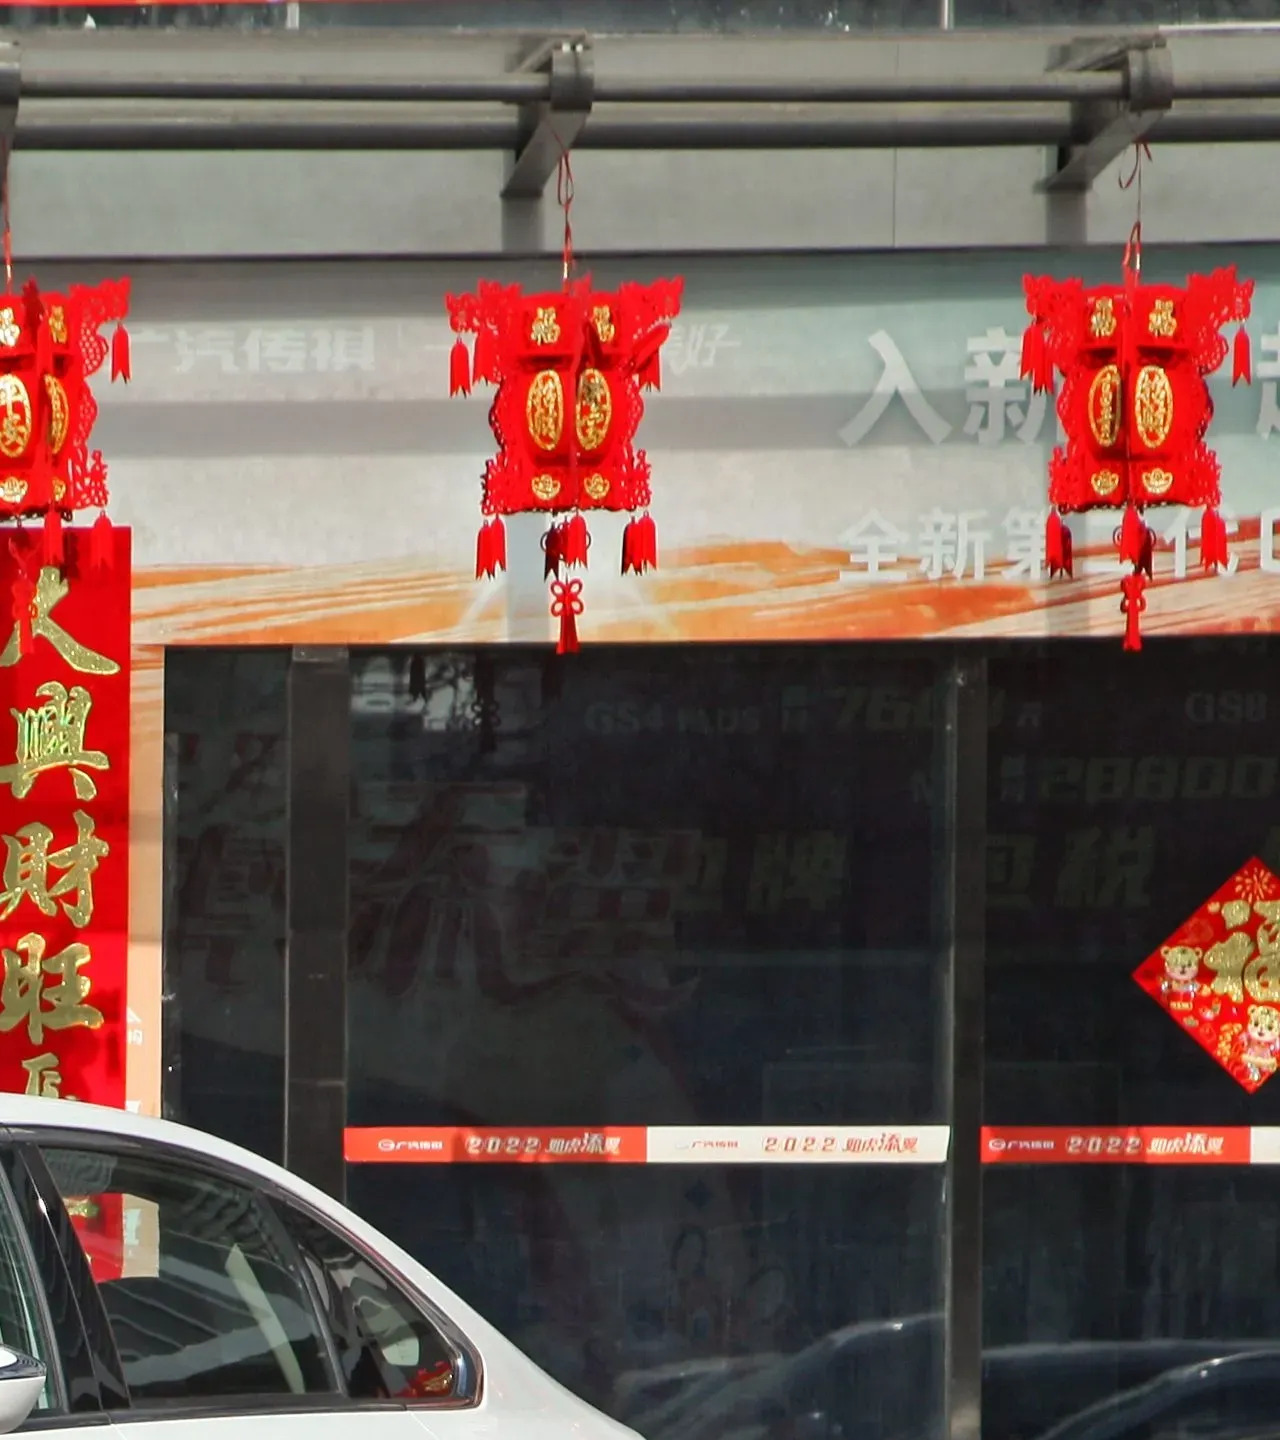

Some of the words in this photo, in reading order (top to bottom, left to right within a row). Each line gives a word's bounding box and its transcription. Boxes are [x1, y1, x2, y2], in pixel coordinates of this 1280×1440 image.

[464, 1136, 541, 1155] 2022
[764, 1136, 836, 1153] 2022
[1066, 1135, 1143, 1155] 2022
